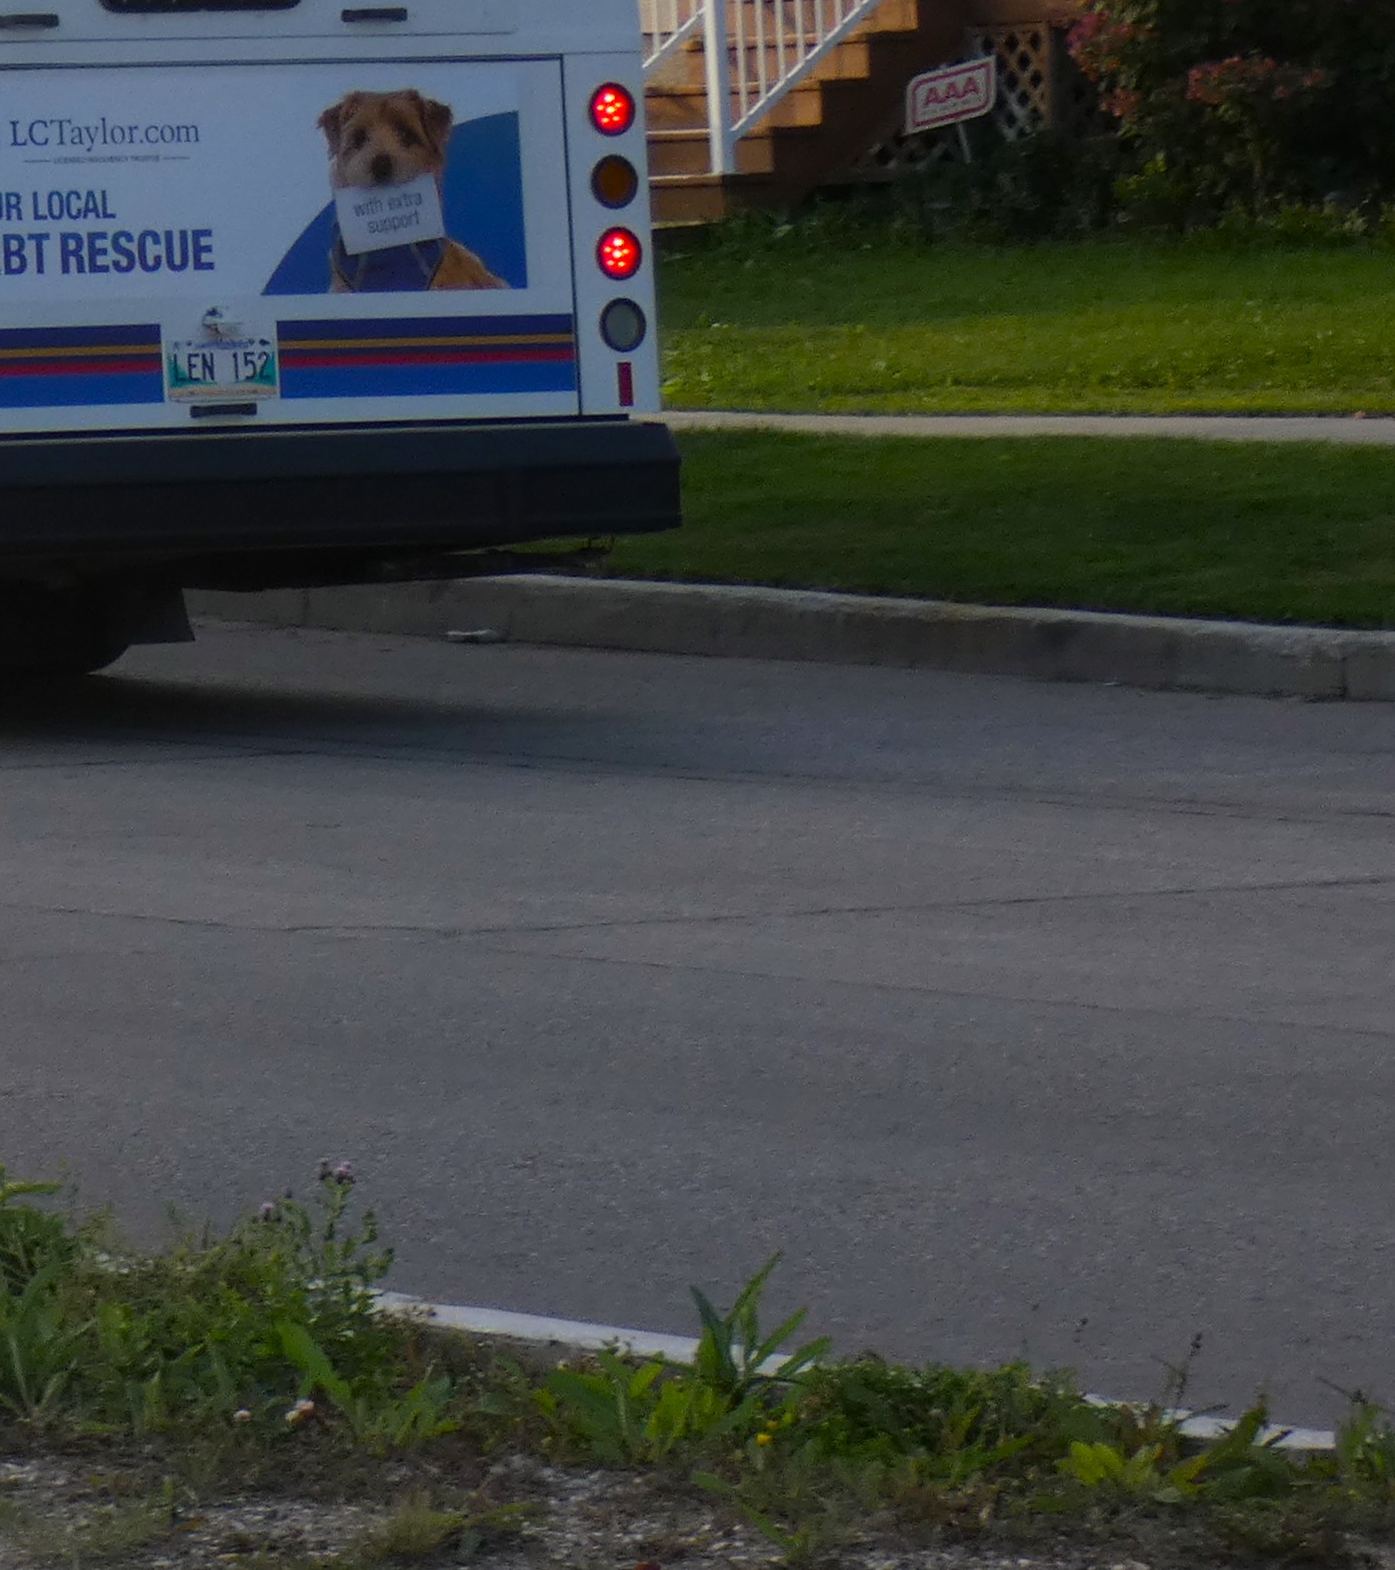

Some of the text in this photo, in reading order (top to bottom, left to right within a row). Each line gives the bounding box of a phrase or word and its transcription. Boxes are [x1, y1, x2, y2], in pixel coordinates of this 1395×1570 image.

[923, 76, 980, 106] AAA
[10, 117, 200, 152] LCTaylor.com
[32, 189, 117, 221] LOCAL
[353, 193, 422, 217] with extra
[368, 209, 420, 234] support
[60, 228, 215, 274] RESCUE
[173, 350, 271, 382] LEN 152
